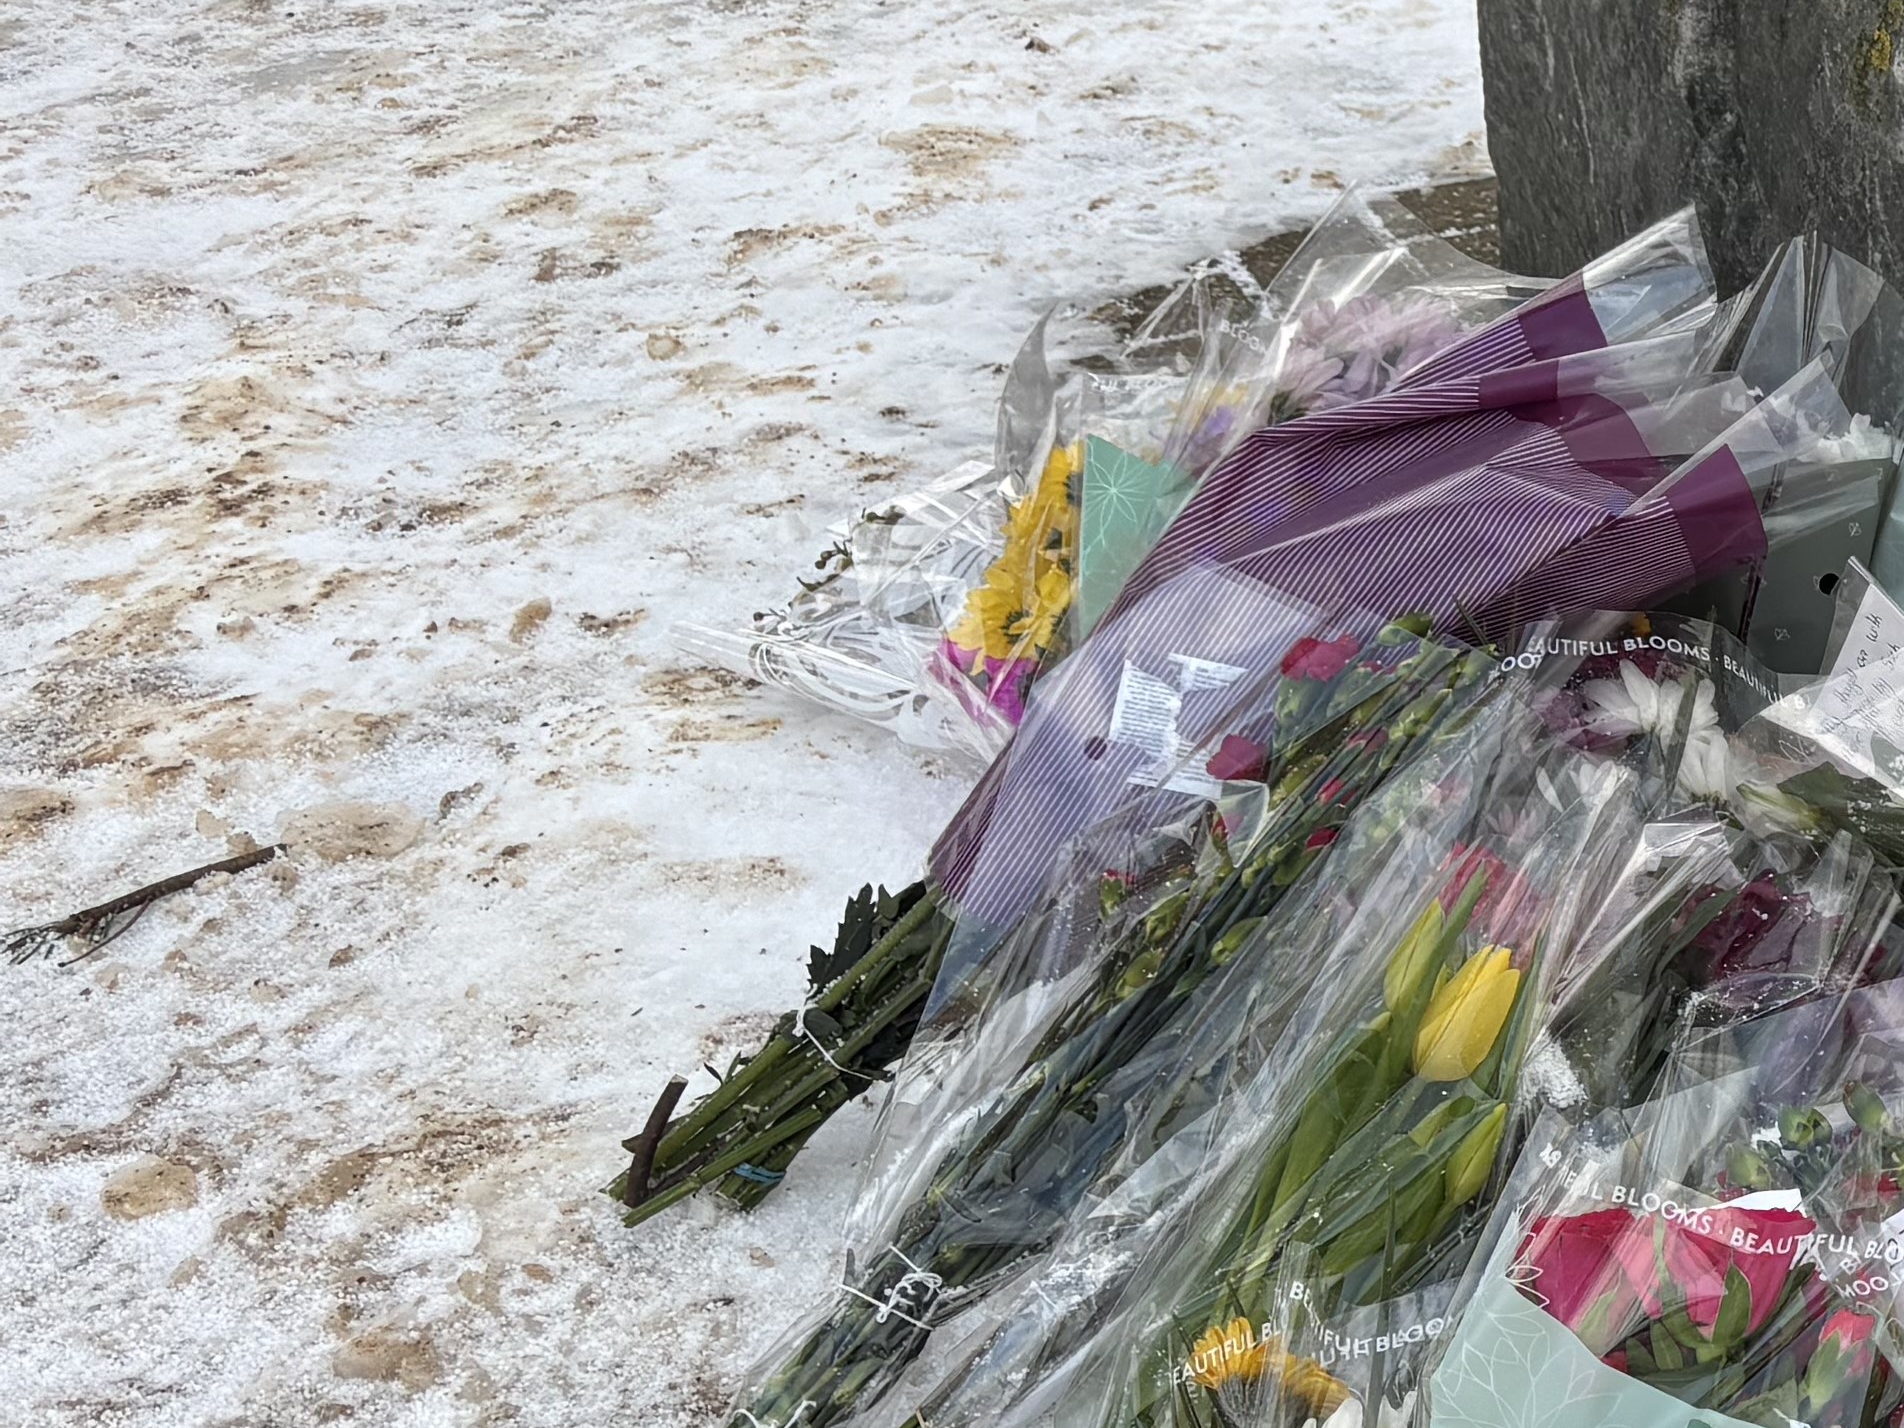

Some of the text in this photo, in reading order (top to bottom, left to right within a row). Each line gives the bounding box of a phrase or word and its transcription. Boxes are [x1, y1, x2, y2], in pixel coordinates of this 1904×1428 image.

[1623, 636, 1711, 662] BLOOMS
[1611, 1184, 1713, 1235] BLOOMS
[1729, 1226, 1857, 1257] BEAUTIFUL
